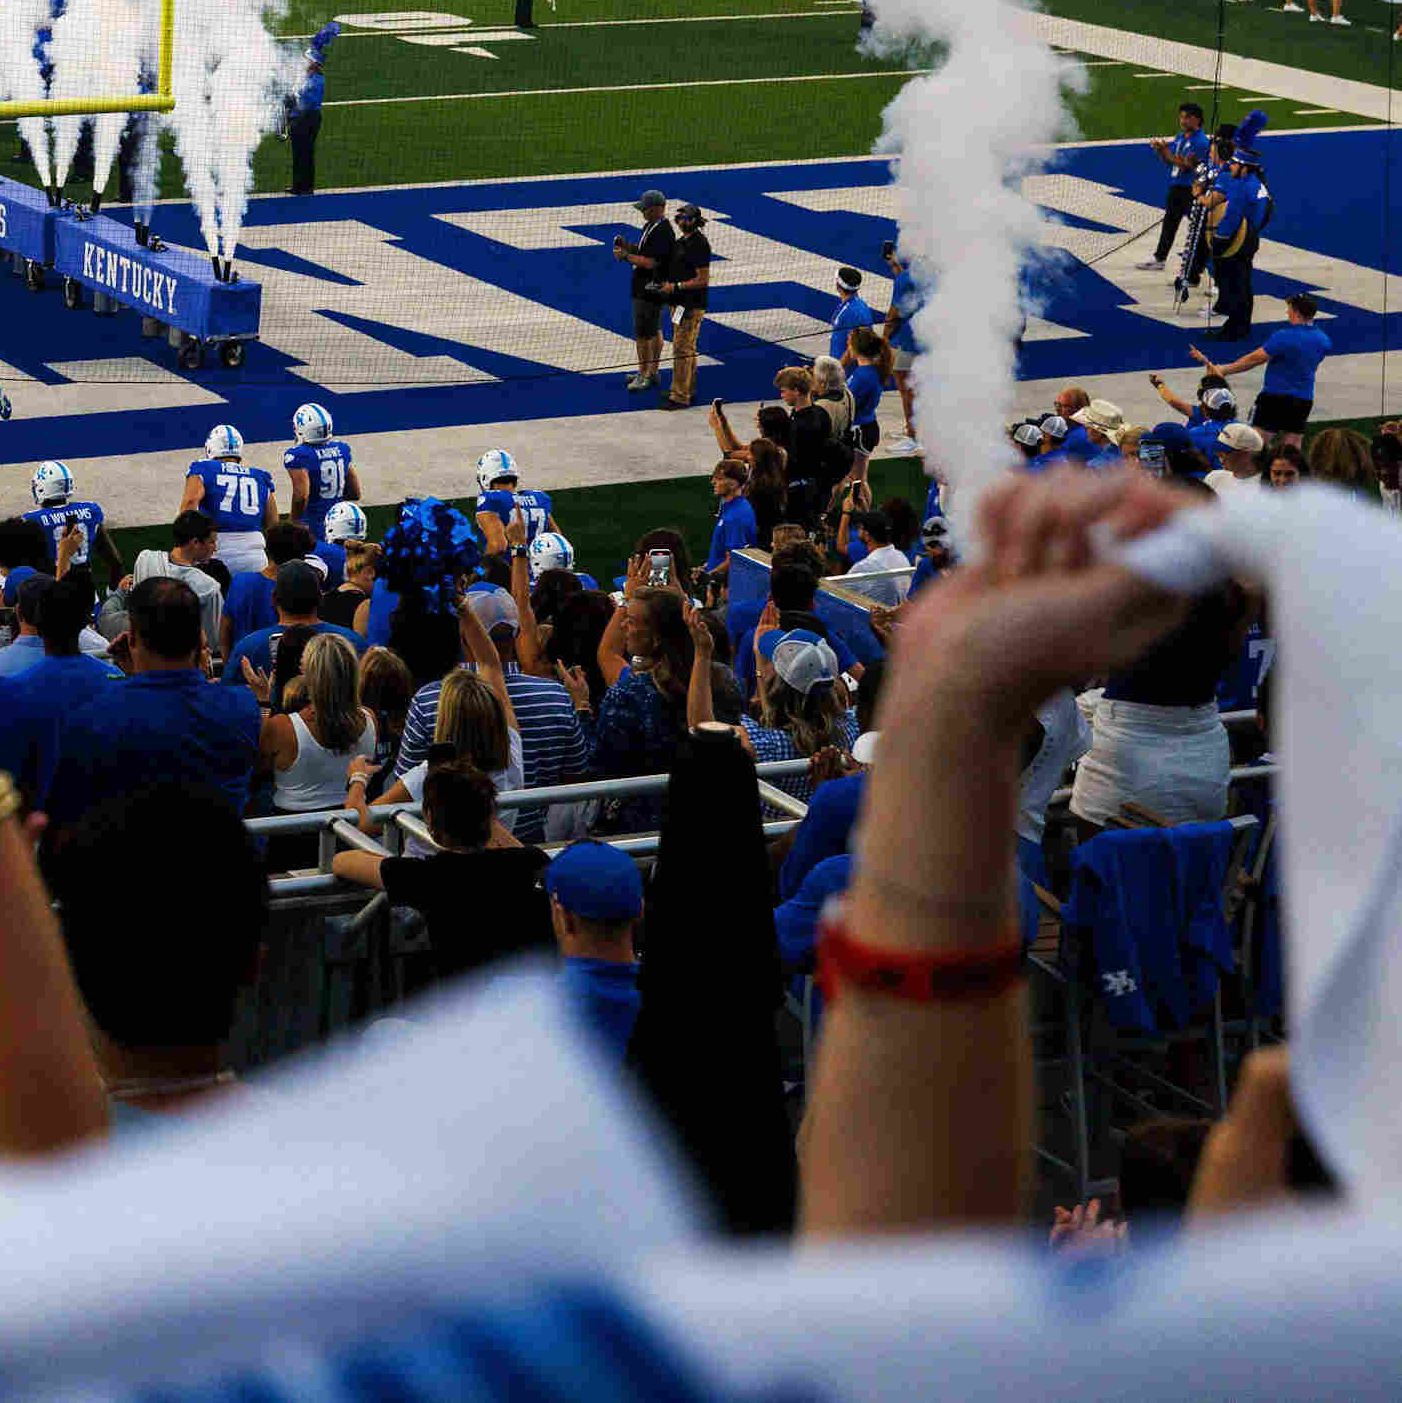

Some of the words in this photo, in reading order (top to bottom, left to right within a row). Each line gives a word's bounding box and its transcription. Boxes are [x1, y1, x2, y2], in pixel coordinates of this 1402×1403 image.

[83, 241, 178, 314] KENTUCKY
[215, 474, 260, 515] 70
[319, 460, 346, 499] 91
